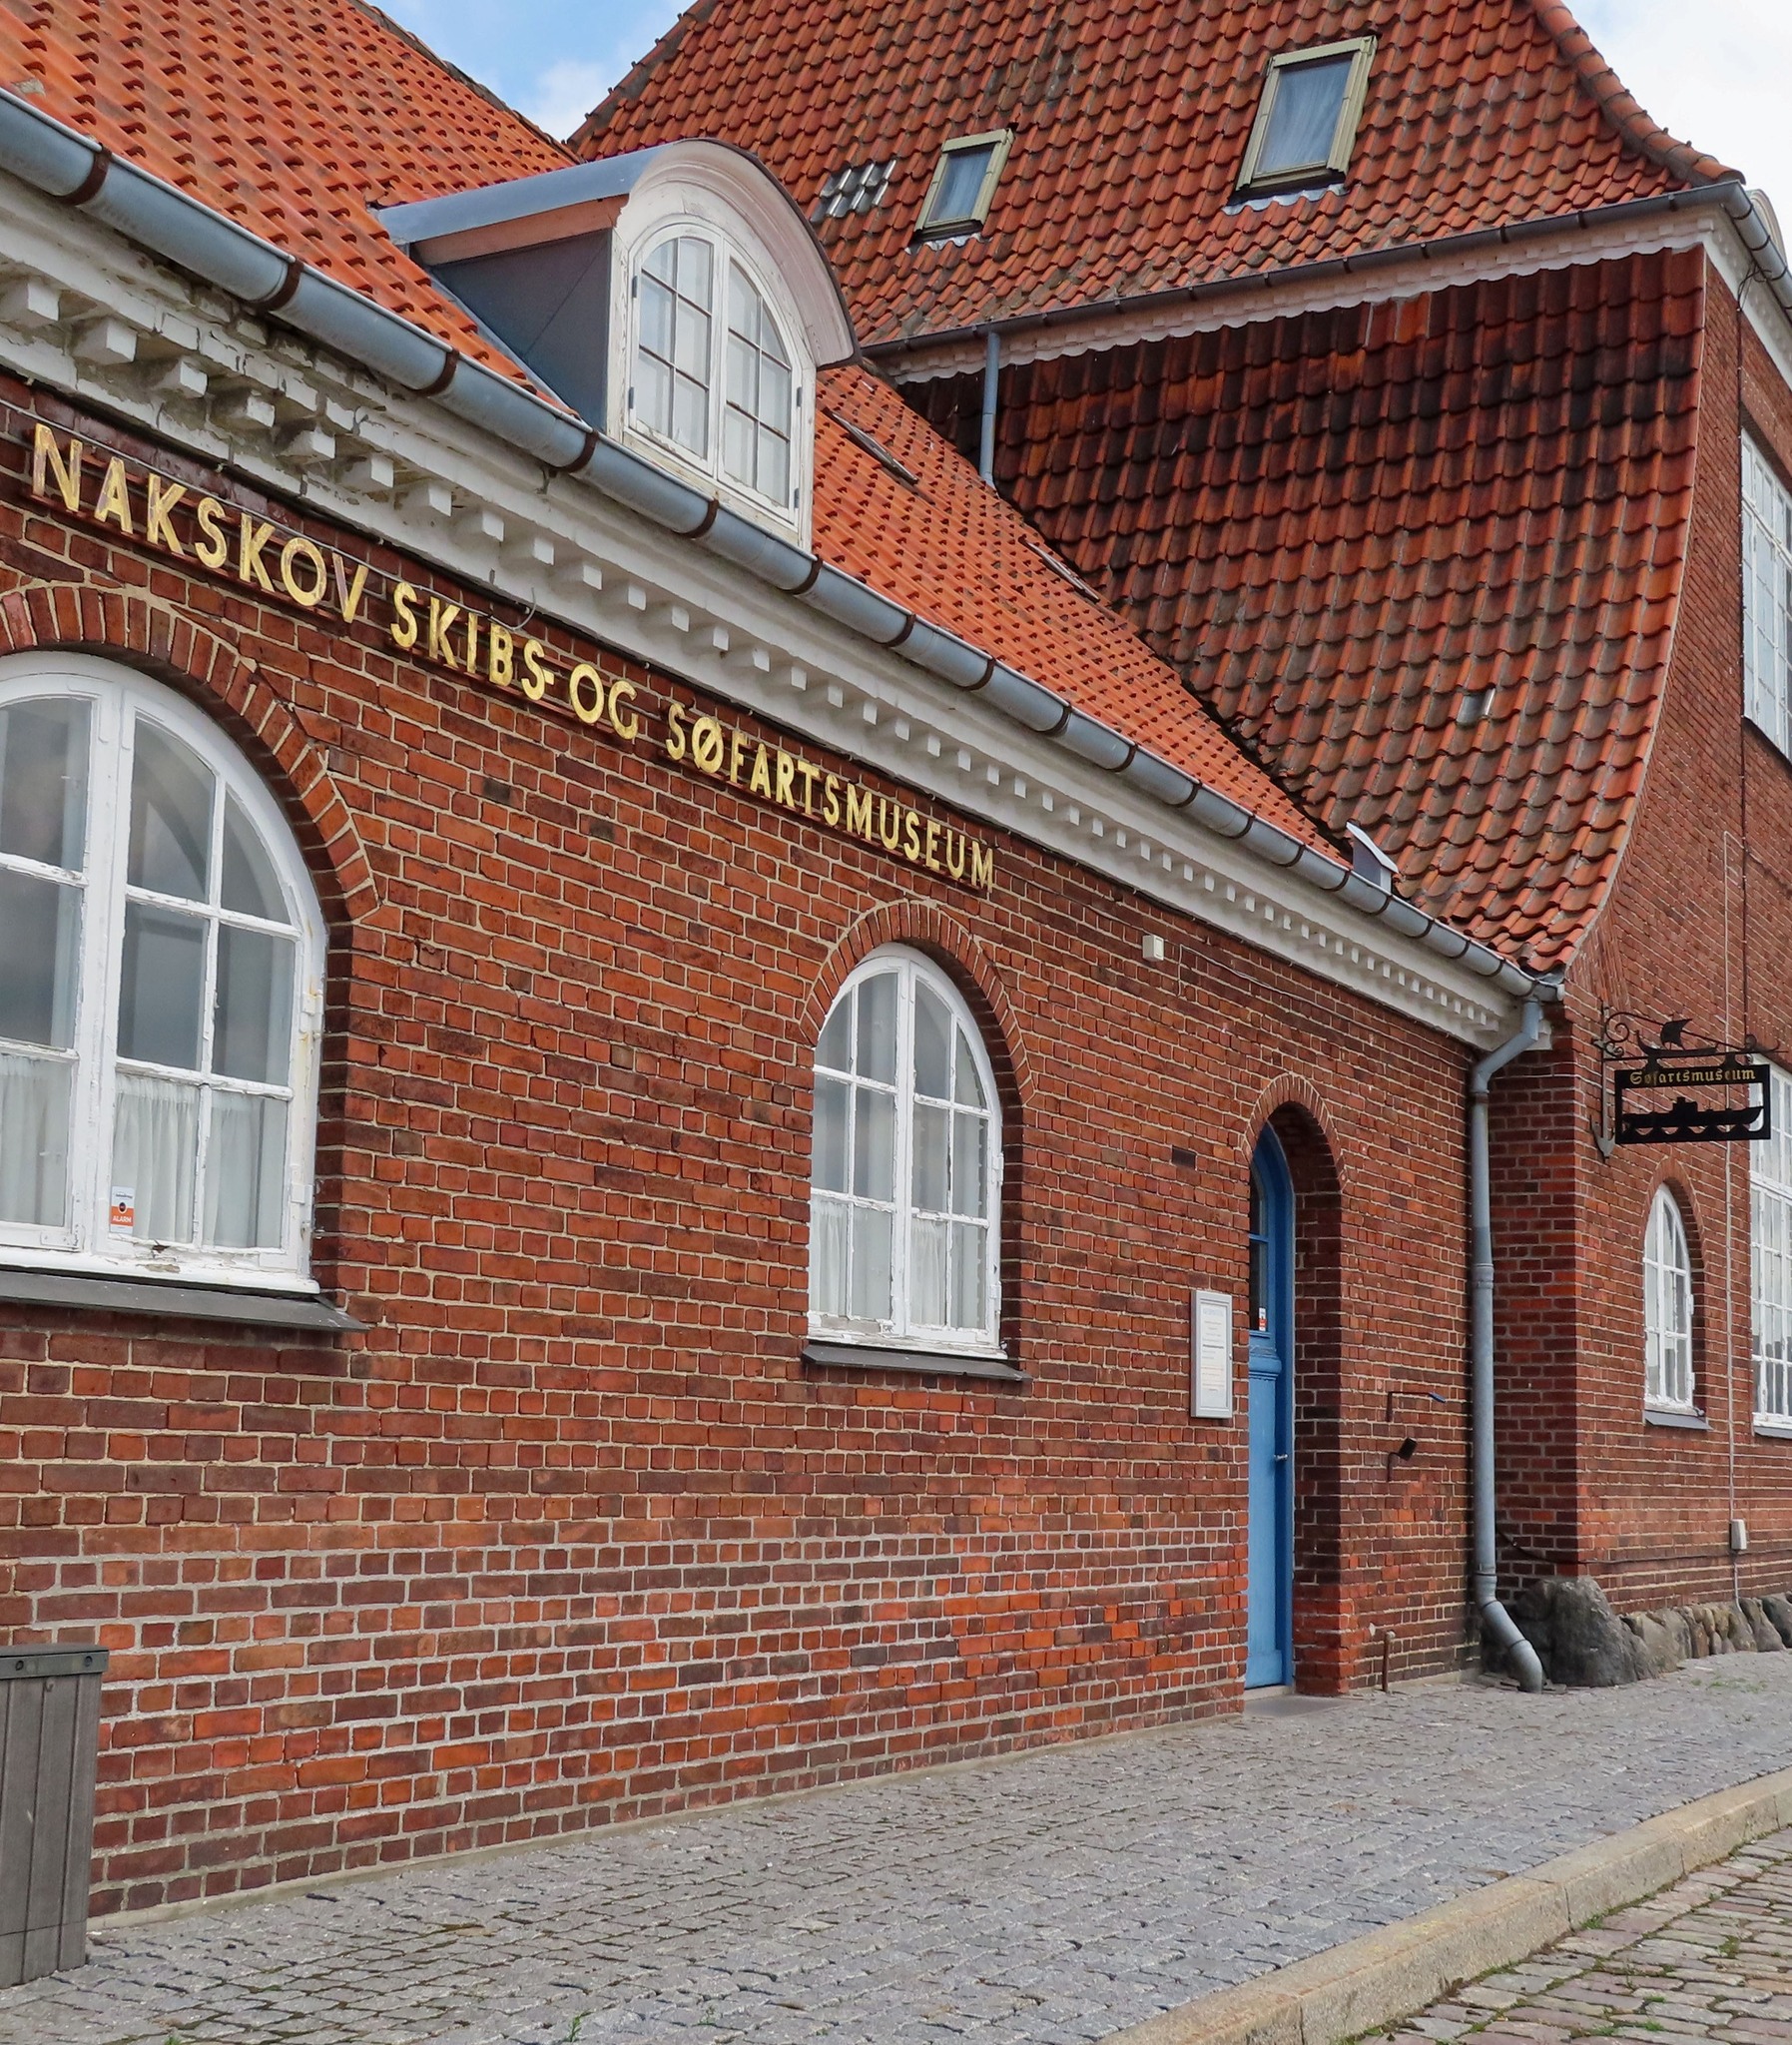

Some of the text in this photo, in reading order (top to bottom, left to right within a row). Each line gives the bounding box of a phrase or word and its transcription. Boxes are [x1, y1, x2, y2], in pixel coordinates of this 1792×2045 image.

[32, 423, 993, 893] NAKSKOV SKIBS- OG SØFARTSMUSEUM
